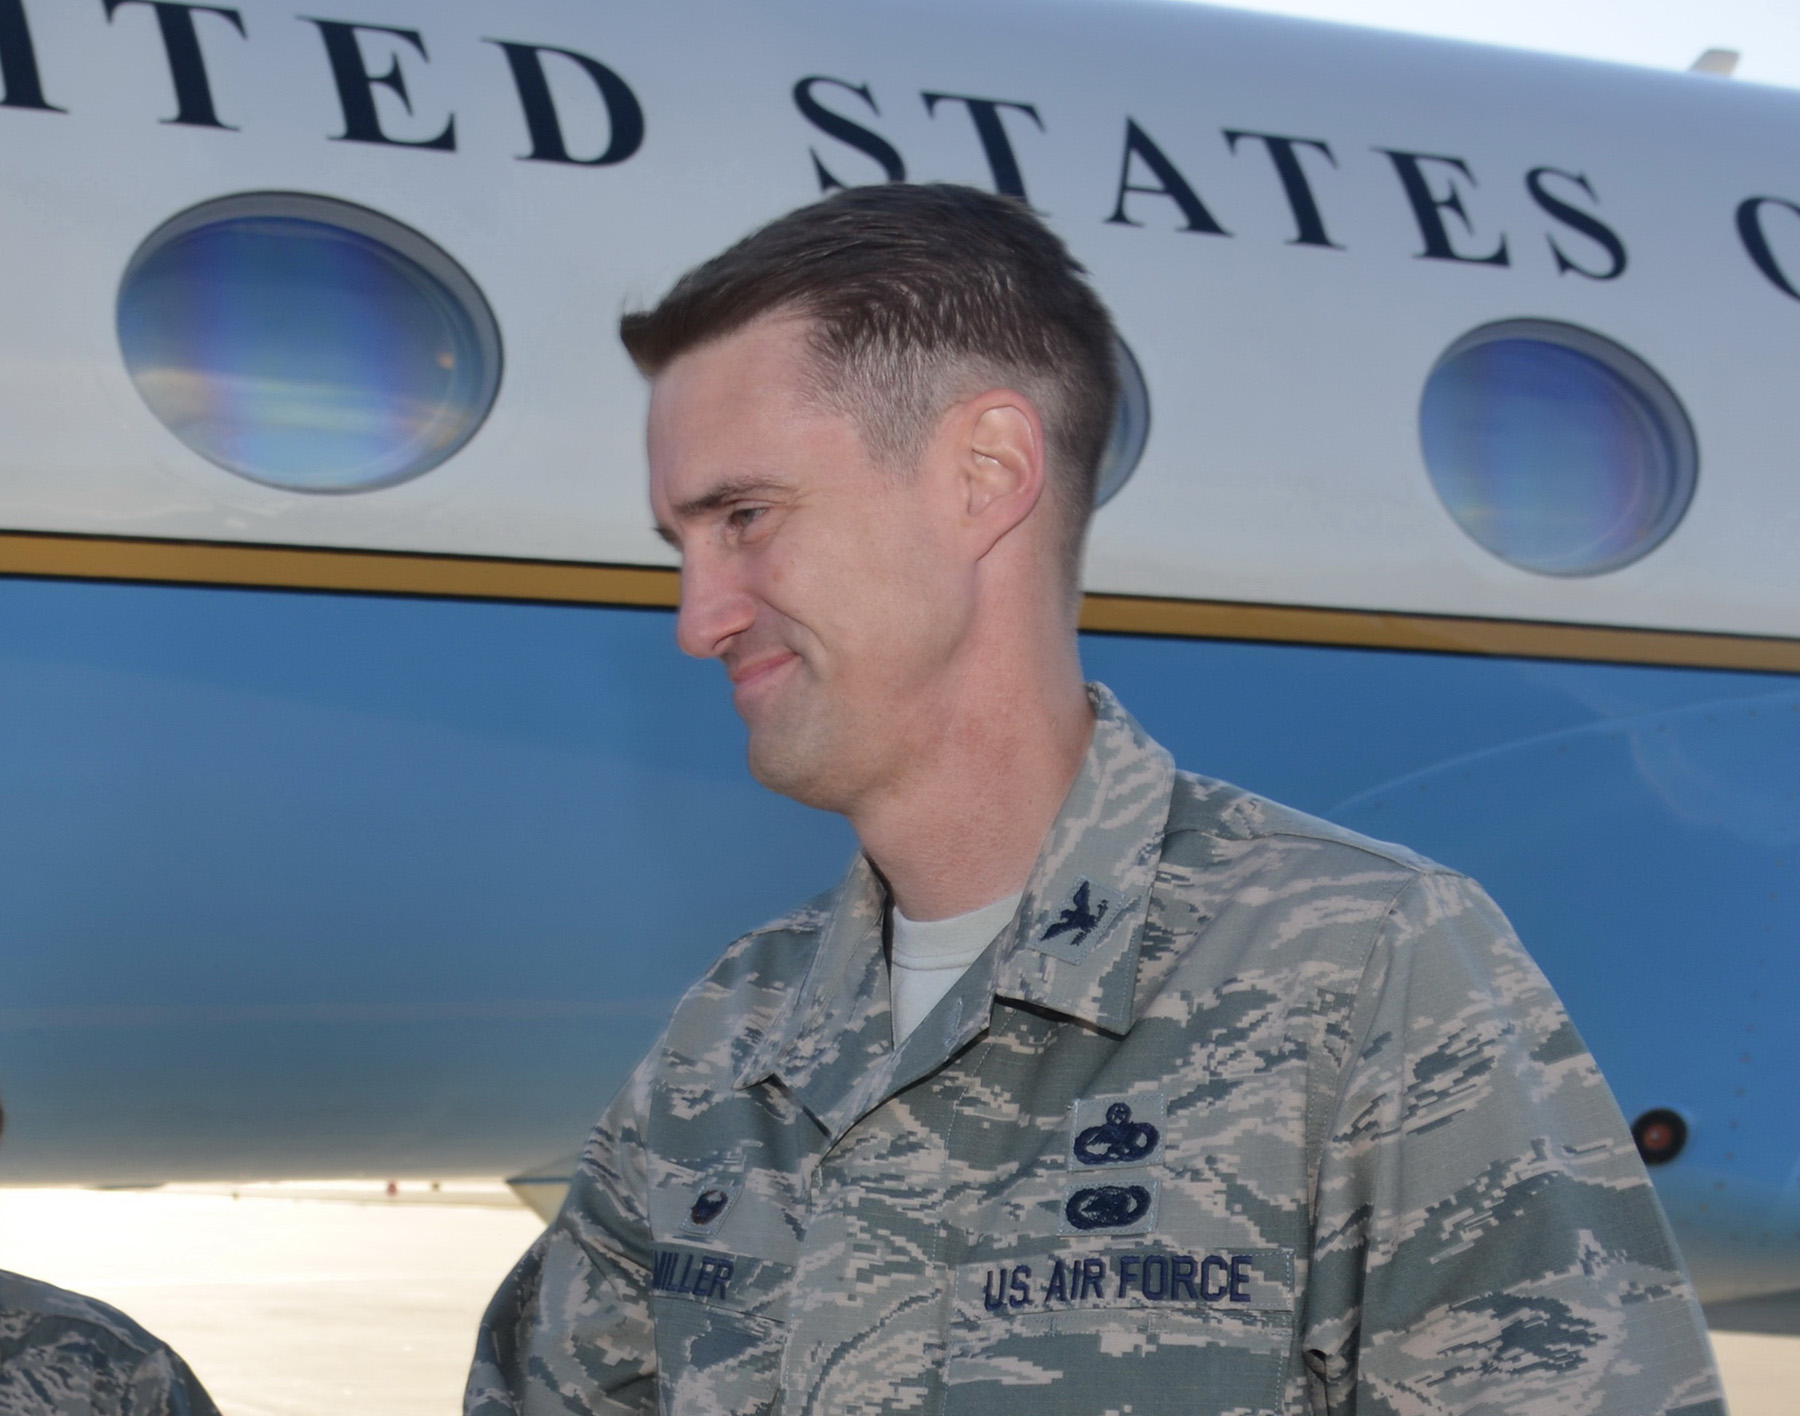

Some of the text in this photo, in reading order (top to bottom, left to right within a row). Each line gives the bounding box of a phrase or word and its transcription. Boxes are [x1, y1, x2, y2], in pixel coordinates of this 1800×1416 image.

[792, 74, 1627, 281] STATES
[984, 1255, 1253, 1311] US AIR FORCE
